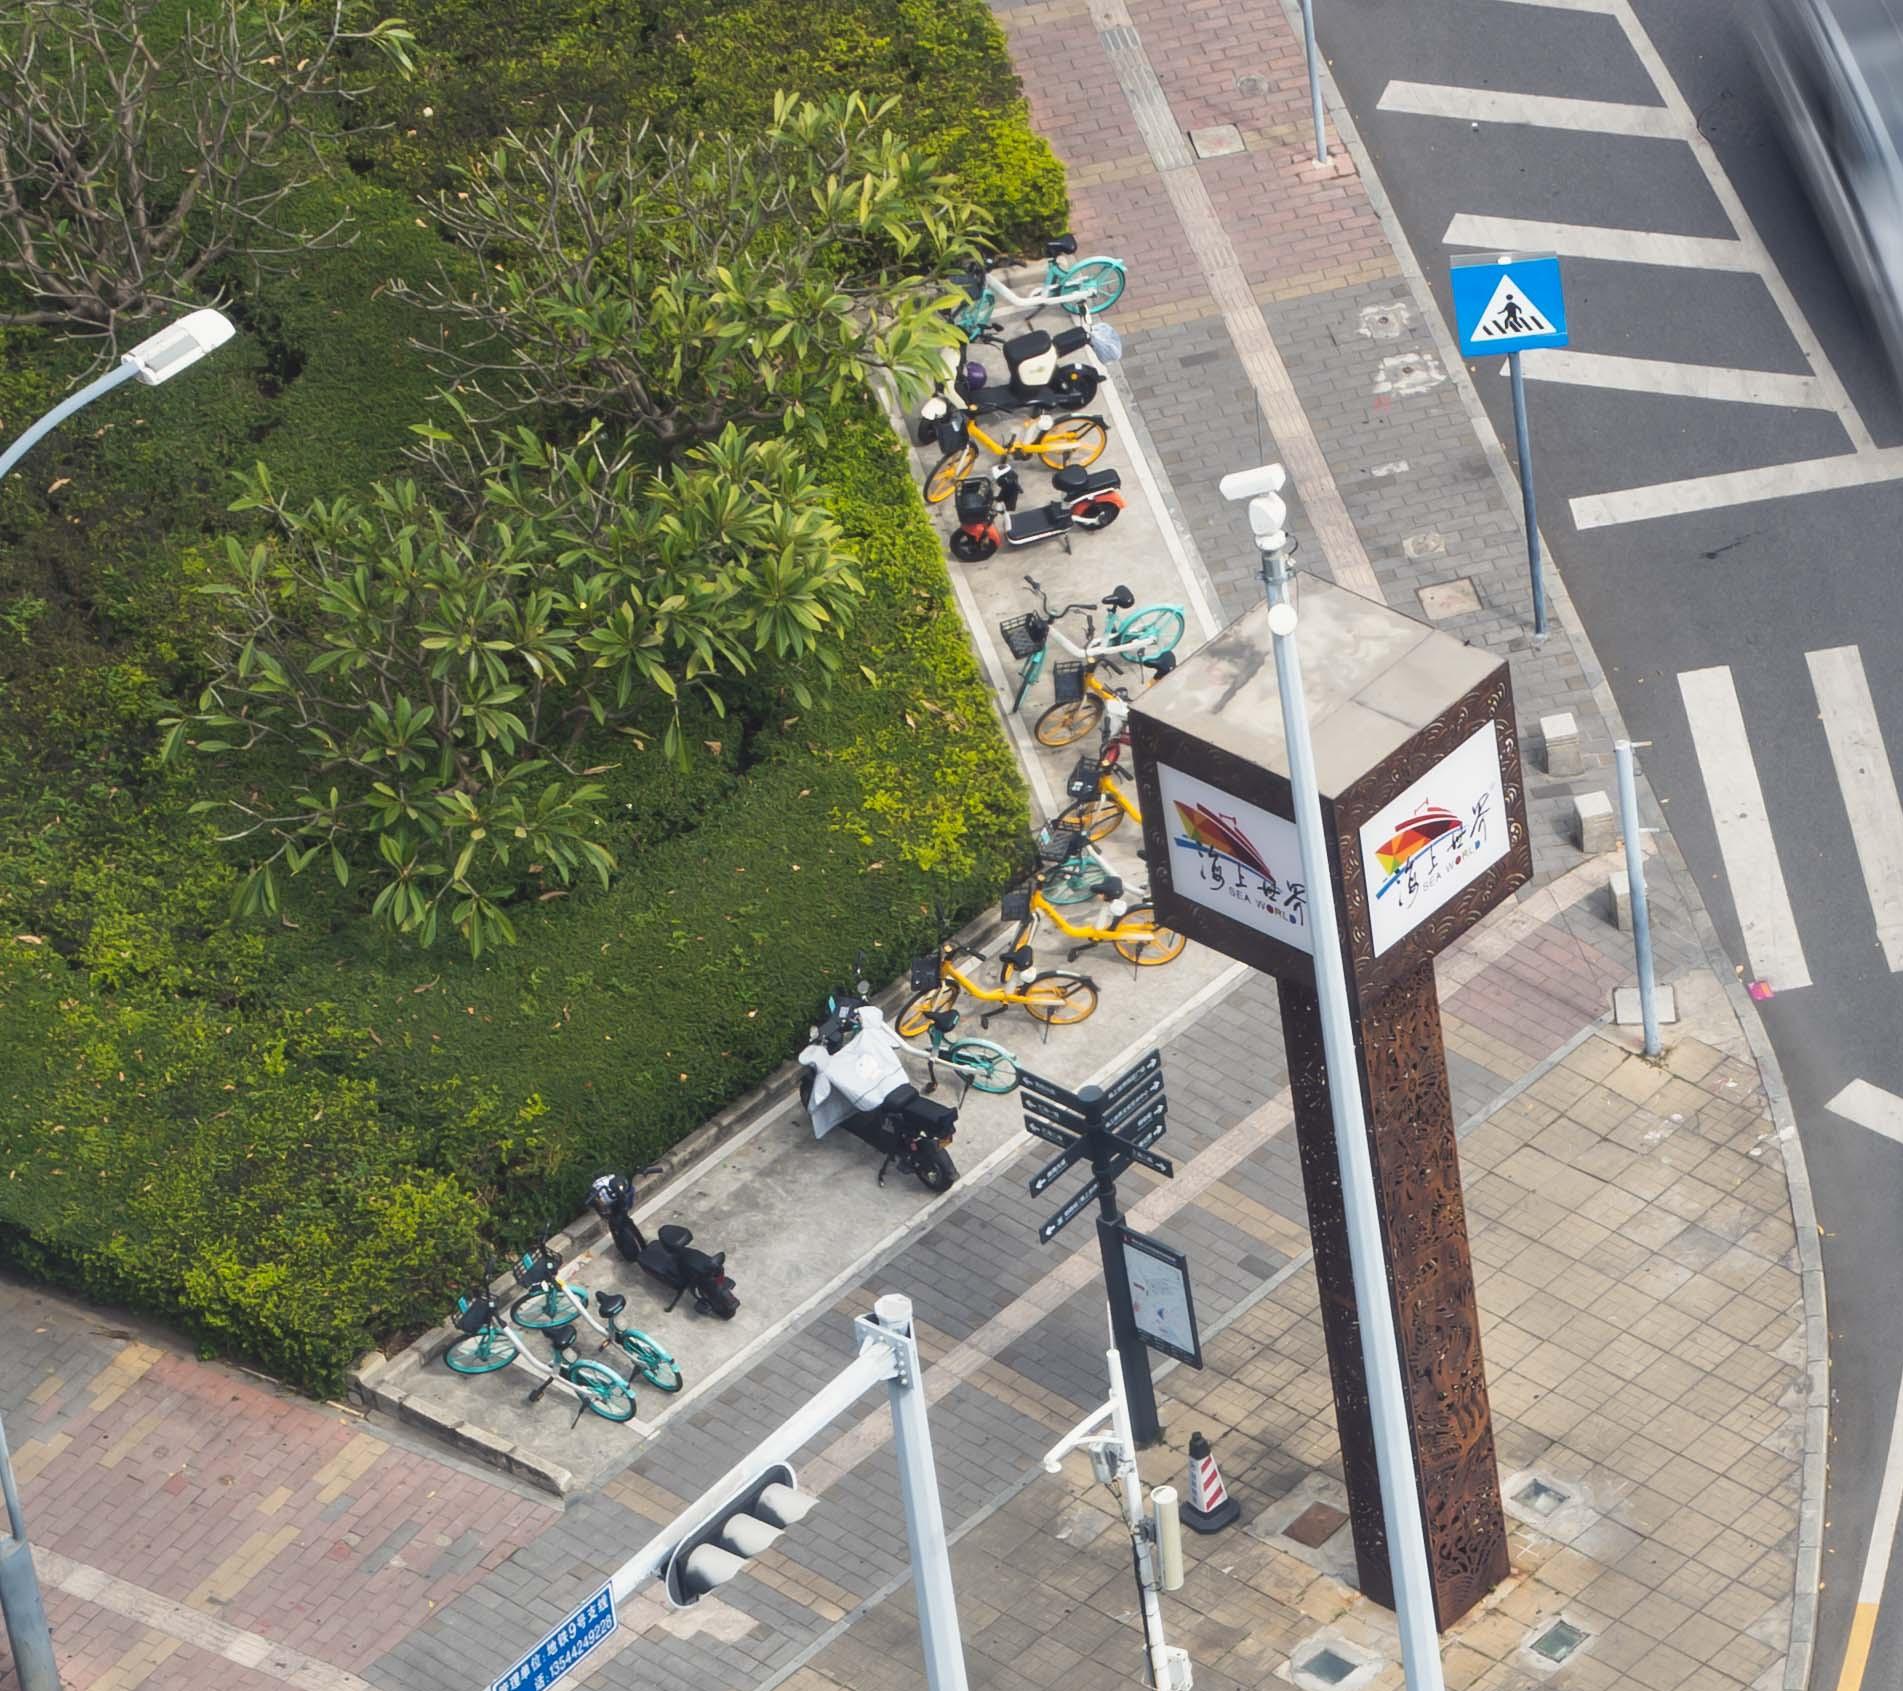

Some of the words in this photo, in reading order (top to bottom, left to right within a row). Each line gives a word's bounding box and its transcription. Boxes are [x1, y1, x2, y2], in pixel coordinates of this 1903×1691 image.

[1423, 872, 1441, 891] SEA
[1446, 840, 1480, 872] WORLD
[1229, 887, 1251, 904] SEA
[1256, 900, 1297, 924] WORLD
